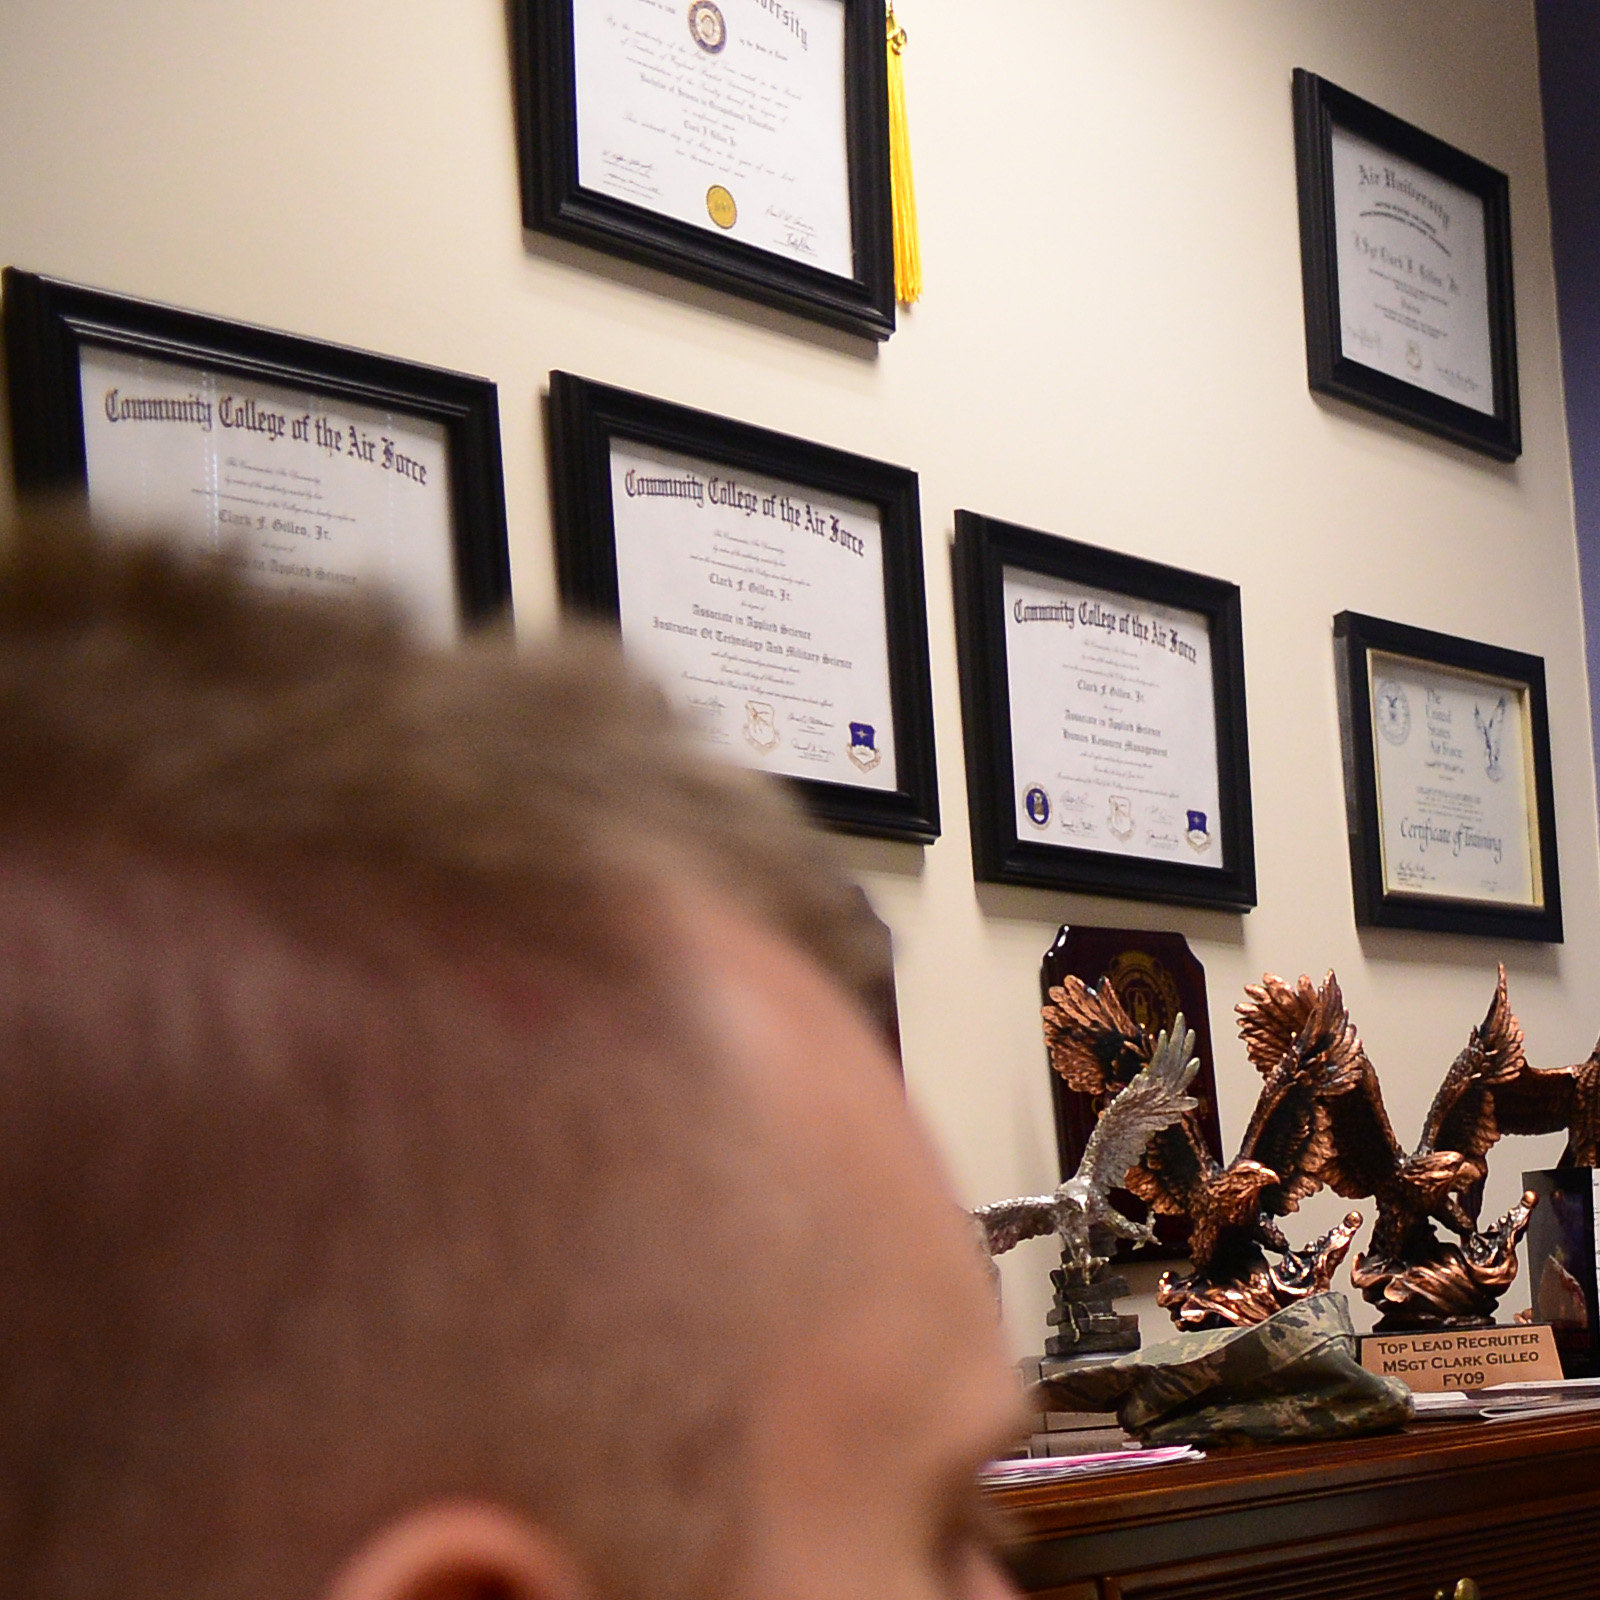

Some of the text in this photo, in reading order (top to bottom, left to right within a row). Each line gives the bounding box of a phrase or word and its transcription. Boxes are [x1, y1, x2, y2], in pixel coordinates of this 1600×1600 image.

[104, 386, 214, 432] Community
[217, 393, 288, 442] College
[290, 412, 312, 443] of
[313, 415, 343, 457] the
[346, 424, 377, 465] Air
[380, 435, 428, 487] Force
[623, 467, 705, 508] Community
[706, 475, 759, 516] College
[761, 492, 778, 518] of
[778, 495, 803, 532] the
[803, 502, 827, 537] Air
[828, 513, 866, 558] Force
[1013, 597, 1076, 631] Community
[1076, 600, 1117, 636] College
[1117, 611, 1131, 638] of
[1131, 614, 1150, 647] the
[1150, 619, 1168, 648] Air
[1168, 628, 1198, 665] Force
[1430, 1354, 1483, 1370] CLARK
[1485, 1350, 1540, 1366] GILLEO
[1456, 1333, 1540, 1350] RECRUITER
[1441, 1371, 1486, 1388] FY09
